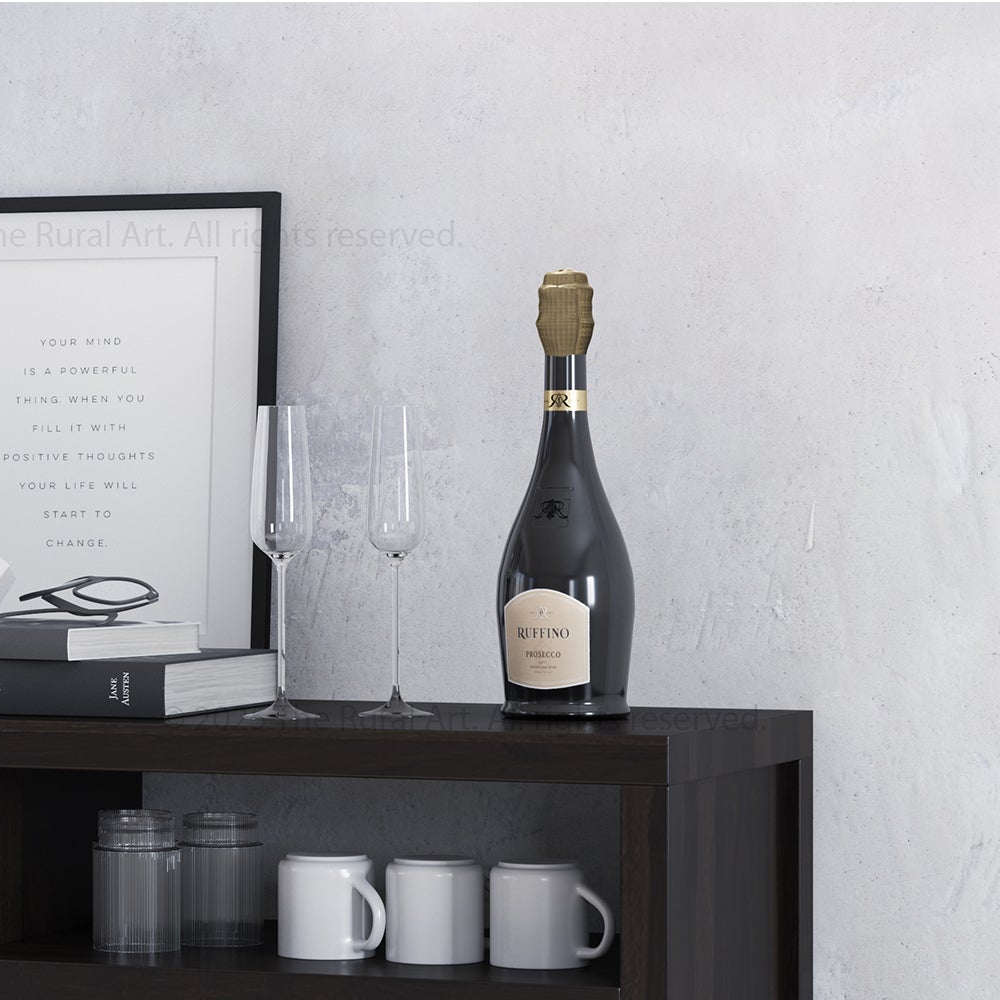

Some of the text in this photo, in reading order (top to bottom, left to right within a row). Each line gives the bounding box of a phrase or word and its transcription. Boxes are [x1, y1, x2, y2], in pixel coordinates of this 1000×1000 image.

[40, 337, 122, 347] YOUR MIND
[23, 366, 137, 376] IS A POWERFUL
[68, 395, 108, 403] WHEN
[117, 394, 145, 403] YOU
[32, 423, 126, 433] FILL IT WITH
[3, 452, 155, 462] POSITIVE THOUGHTS
[19, 481, 137, 490] YOUR LIFE WILL
[43, 510, 112, 519] START TO
[46, 539, 108, 547] CHANGE.
[517, 627, 570, 639] RUFFINO
[526, 650, 561, 659] PROSECCO
[109, 678, 118, 700] JANE
[121, 672, 130, 706] AUSTEN
